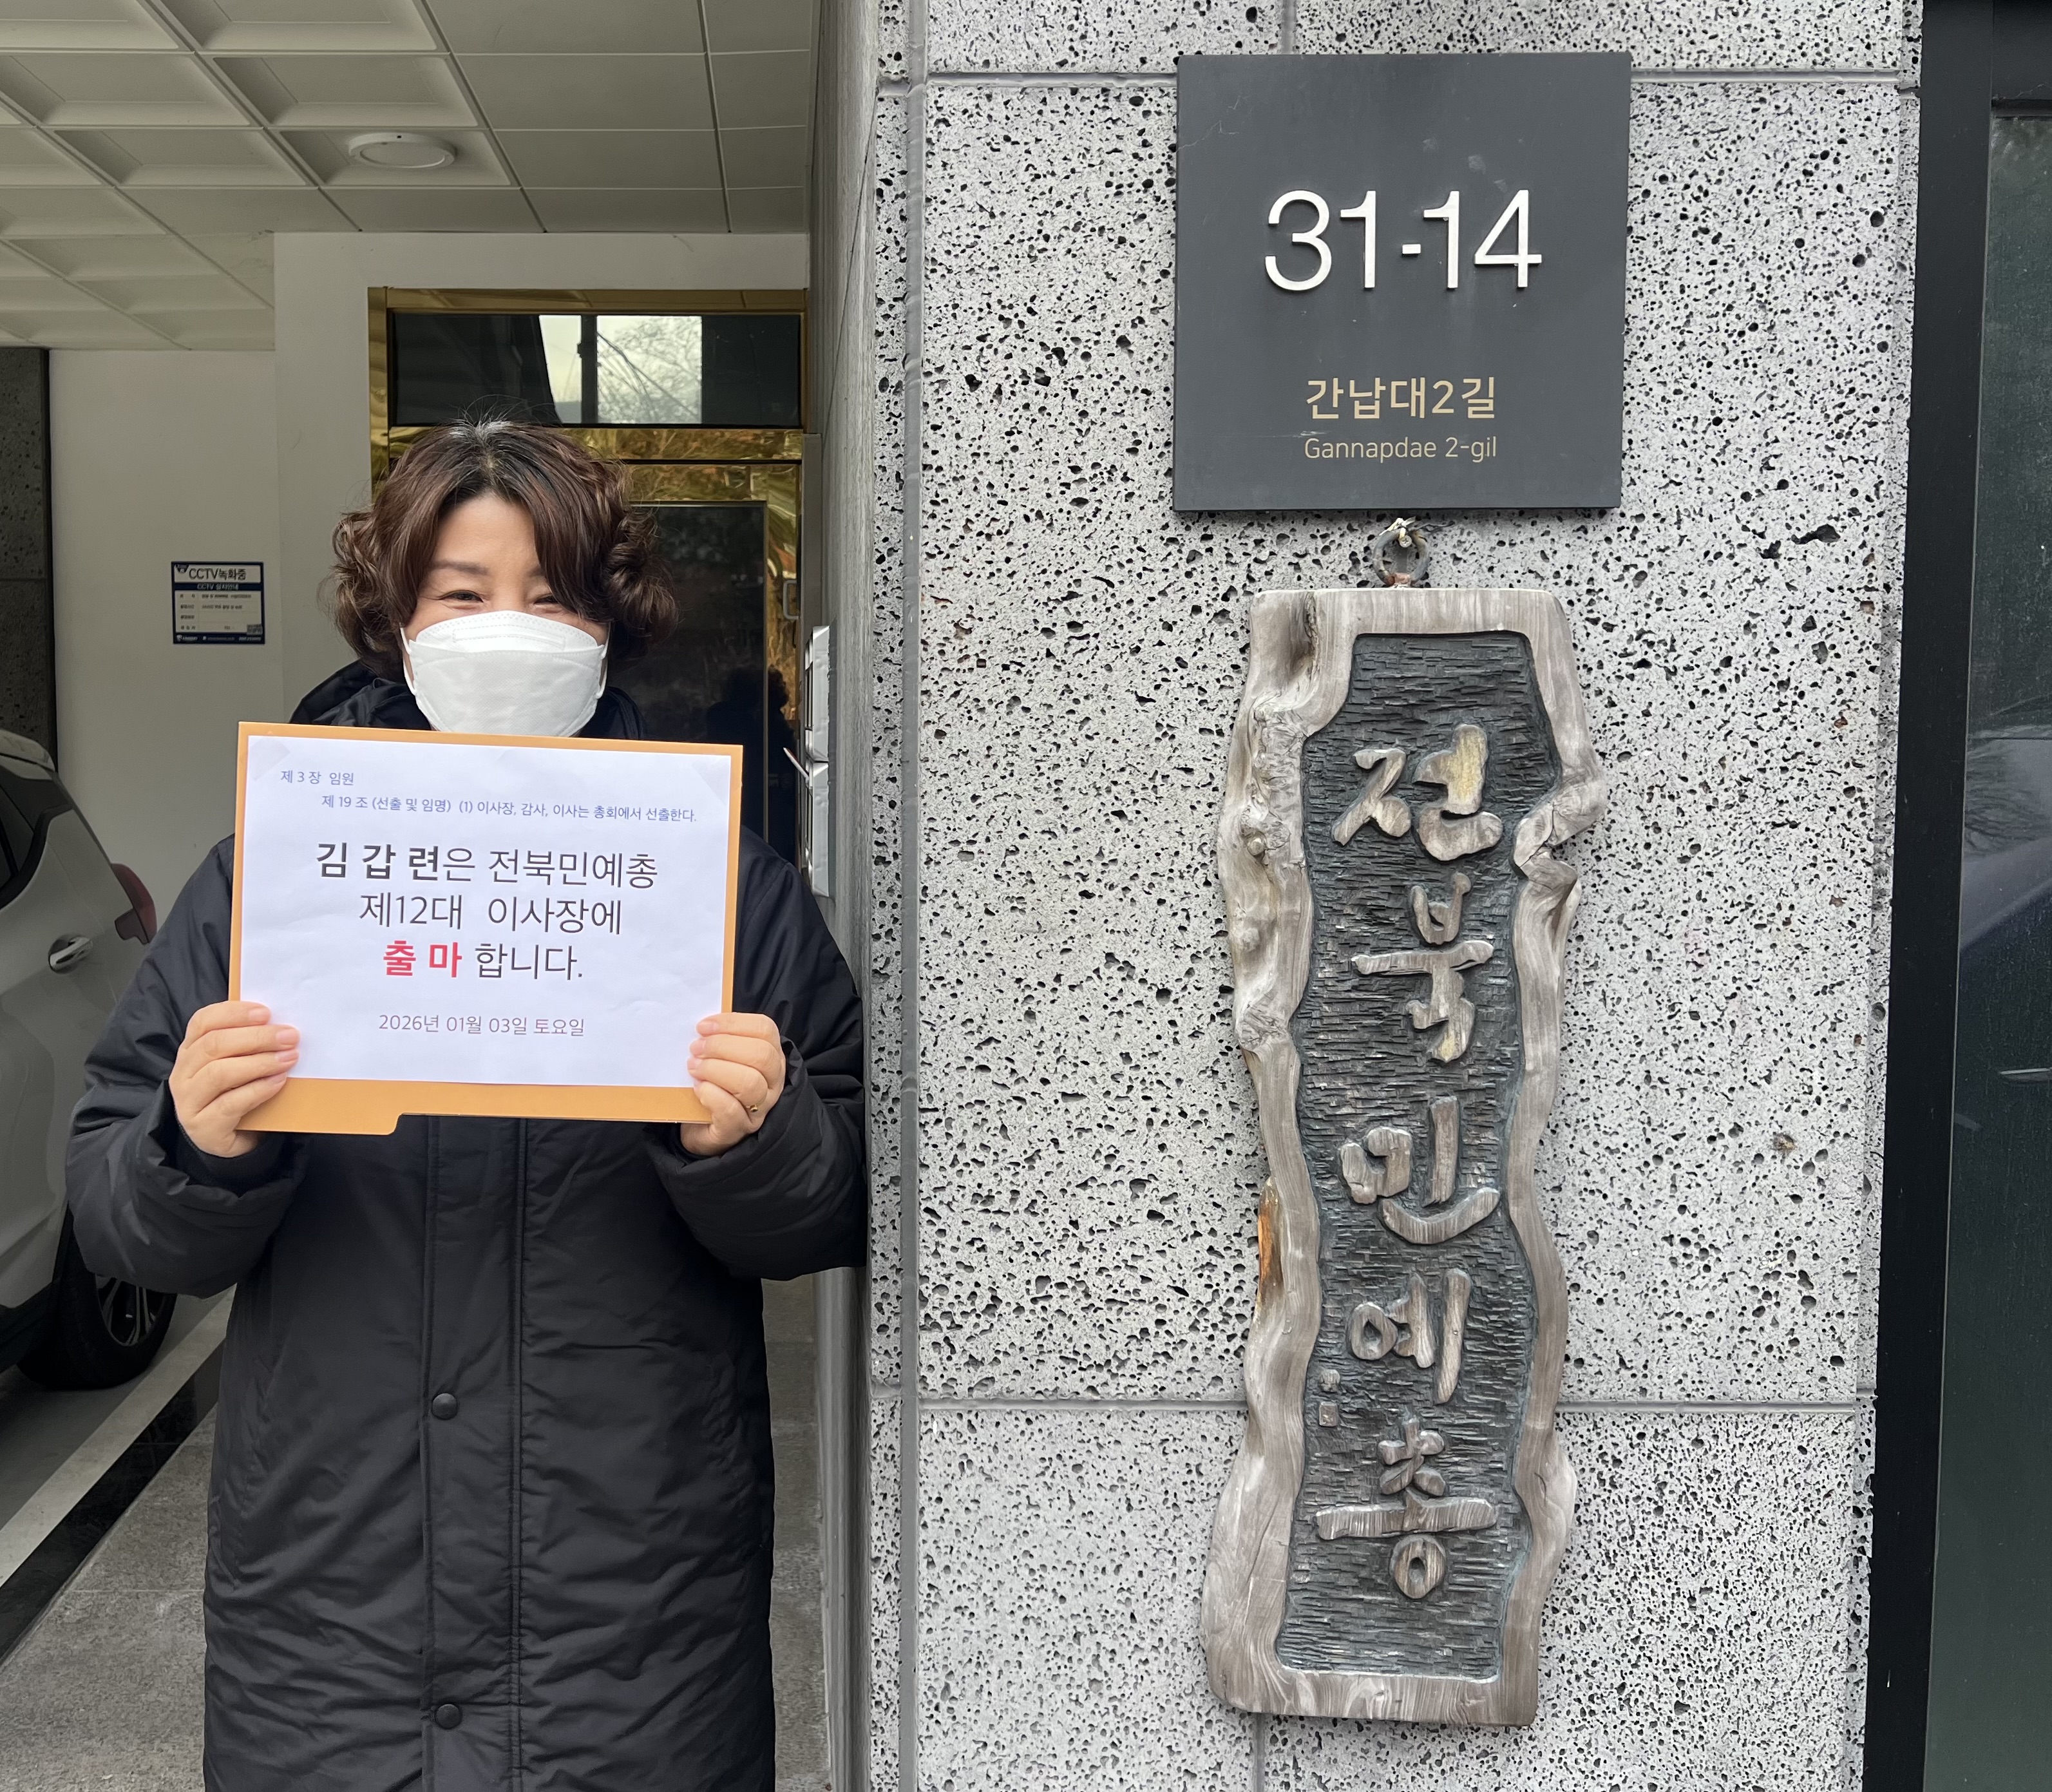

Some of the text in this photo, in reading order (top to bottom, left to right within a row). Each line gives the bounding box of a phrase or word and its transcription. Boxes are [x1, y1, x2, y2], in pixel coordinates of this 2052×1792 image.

[1265, 189, 1542, 291] 31-14
[1306, 377, 1495, 419] 간납대2길
[1304, 437, 1497, 463] Gannapdae 2-gil
[280, 770, 354, 786] 제 3 장 임원
[321, 794, 697, 823] 제 19 조 (선출 및 임명) (1) 이사장, 감사, 이사는 총회에서 선출한다.
[316, 843, 658, 888] 김 갑 련은 전북민예총
[359, 892, 621, 935] 제12대 이사장에
[383, 940, 582, 980] 출 마 합니다.
[379, 1015, 584, 1037] 2026년 01월 03일 토요일
[1315, 723, 1505, 1600] 전북민예총
